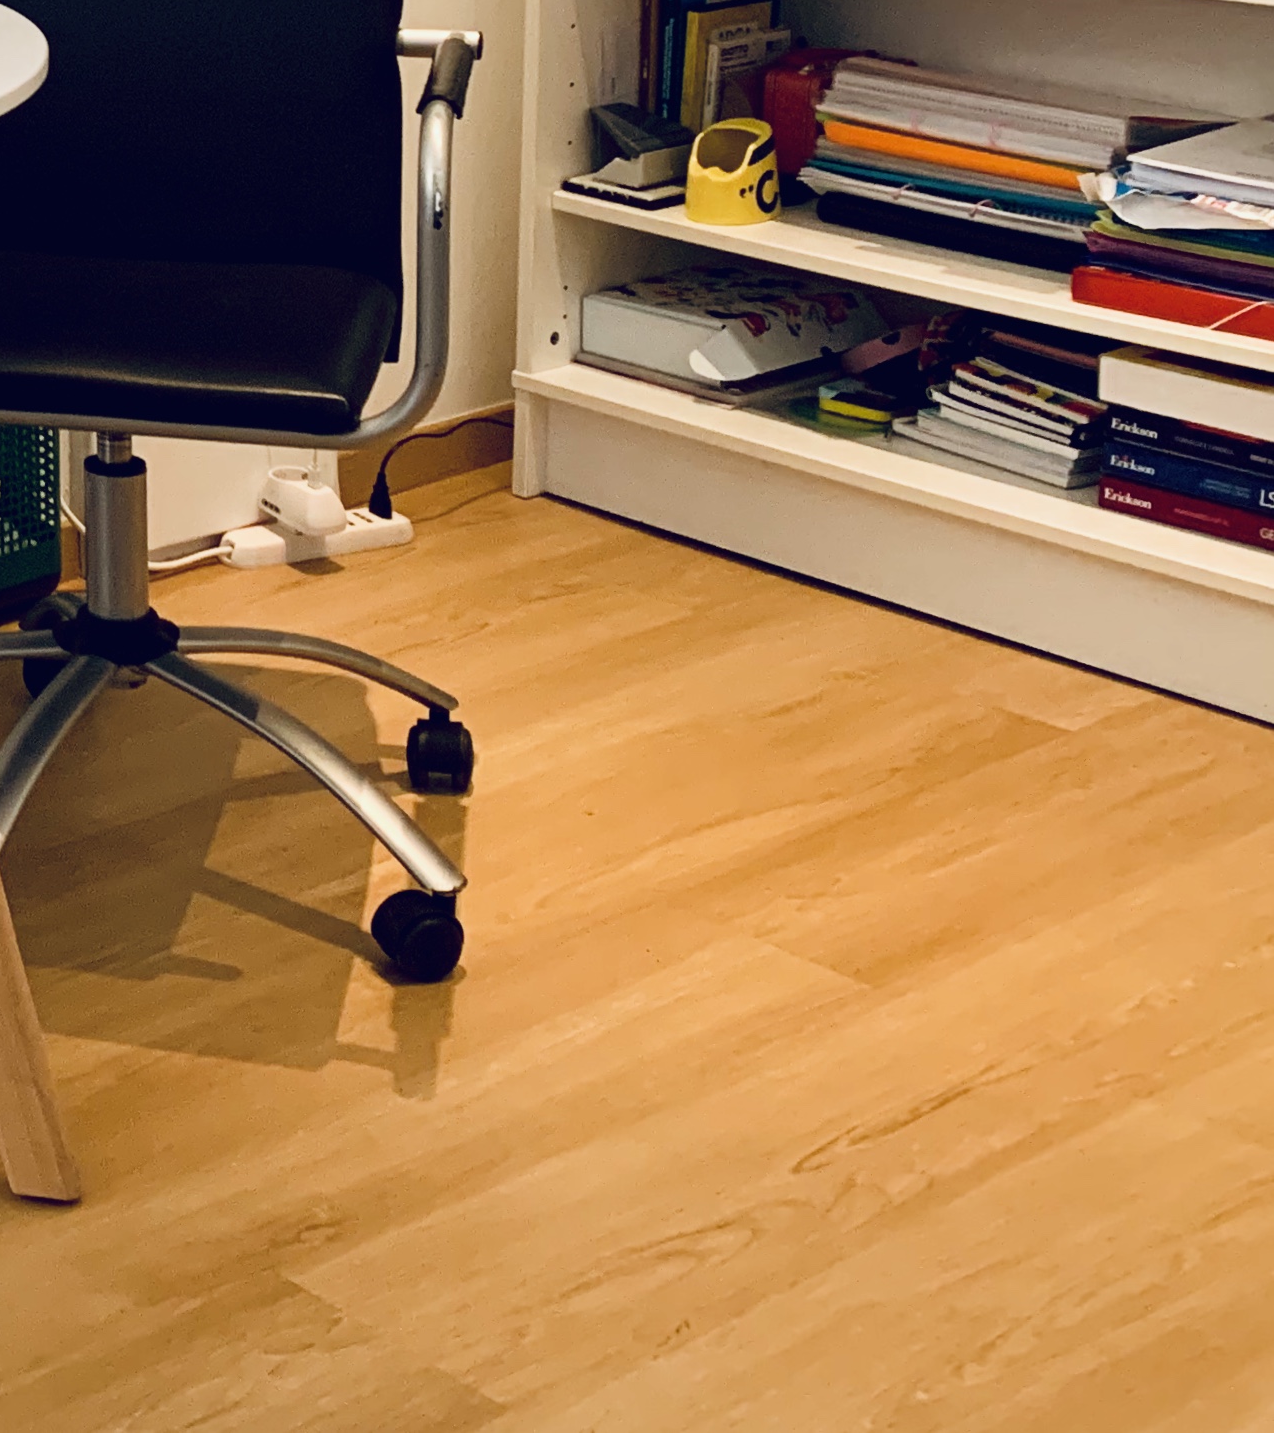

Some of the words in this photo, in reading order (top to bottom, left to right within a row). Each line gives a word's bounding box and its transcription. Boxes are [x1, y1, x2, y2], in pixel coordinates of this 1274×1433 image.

[1110, 417, 1159, 440] Erickson
[1109, 454, 1156, 476] Erickson
[1104, 487, 1153, 509] Erickson
